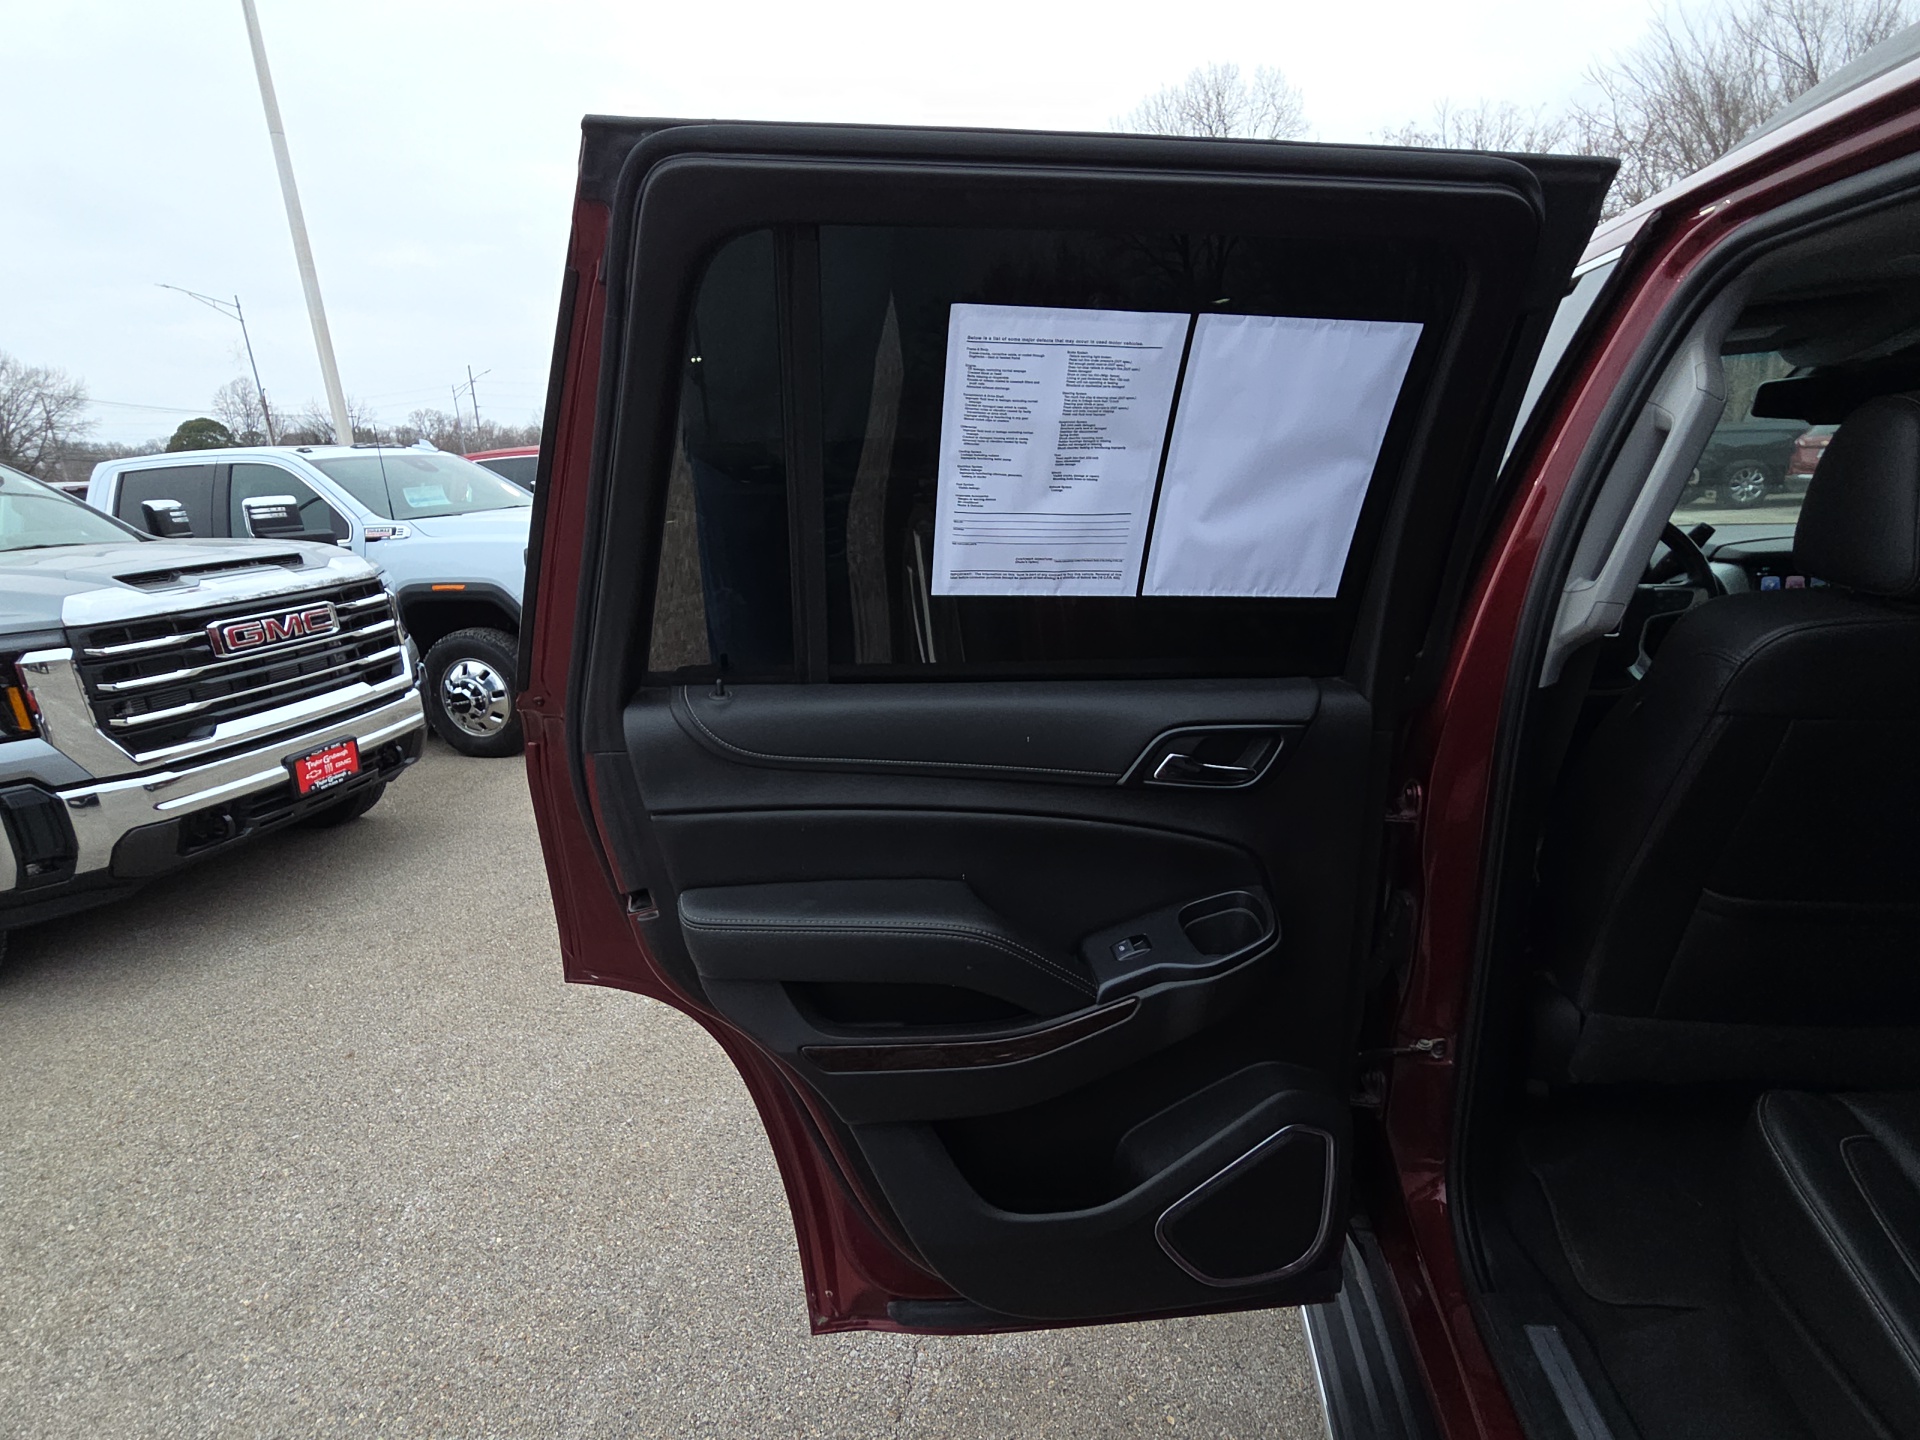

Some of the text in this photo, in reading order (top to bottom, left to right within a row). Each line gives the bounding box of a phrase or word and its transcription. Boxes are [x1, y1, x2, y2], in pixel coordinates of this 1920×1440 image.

[223, 607, 333, 650] GMC
[305, 758, 323, 770] Taylor
[335, 757, 352, 768] GMC
